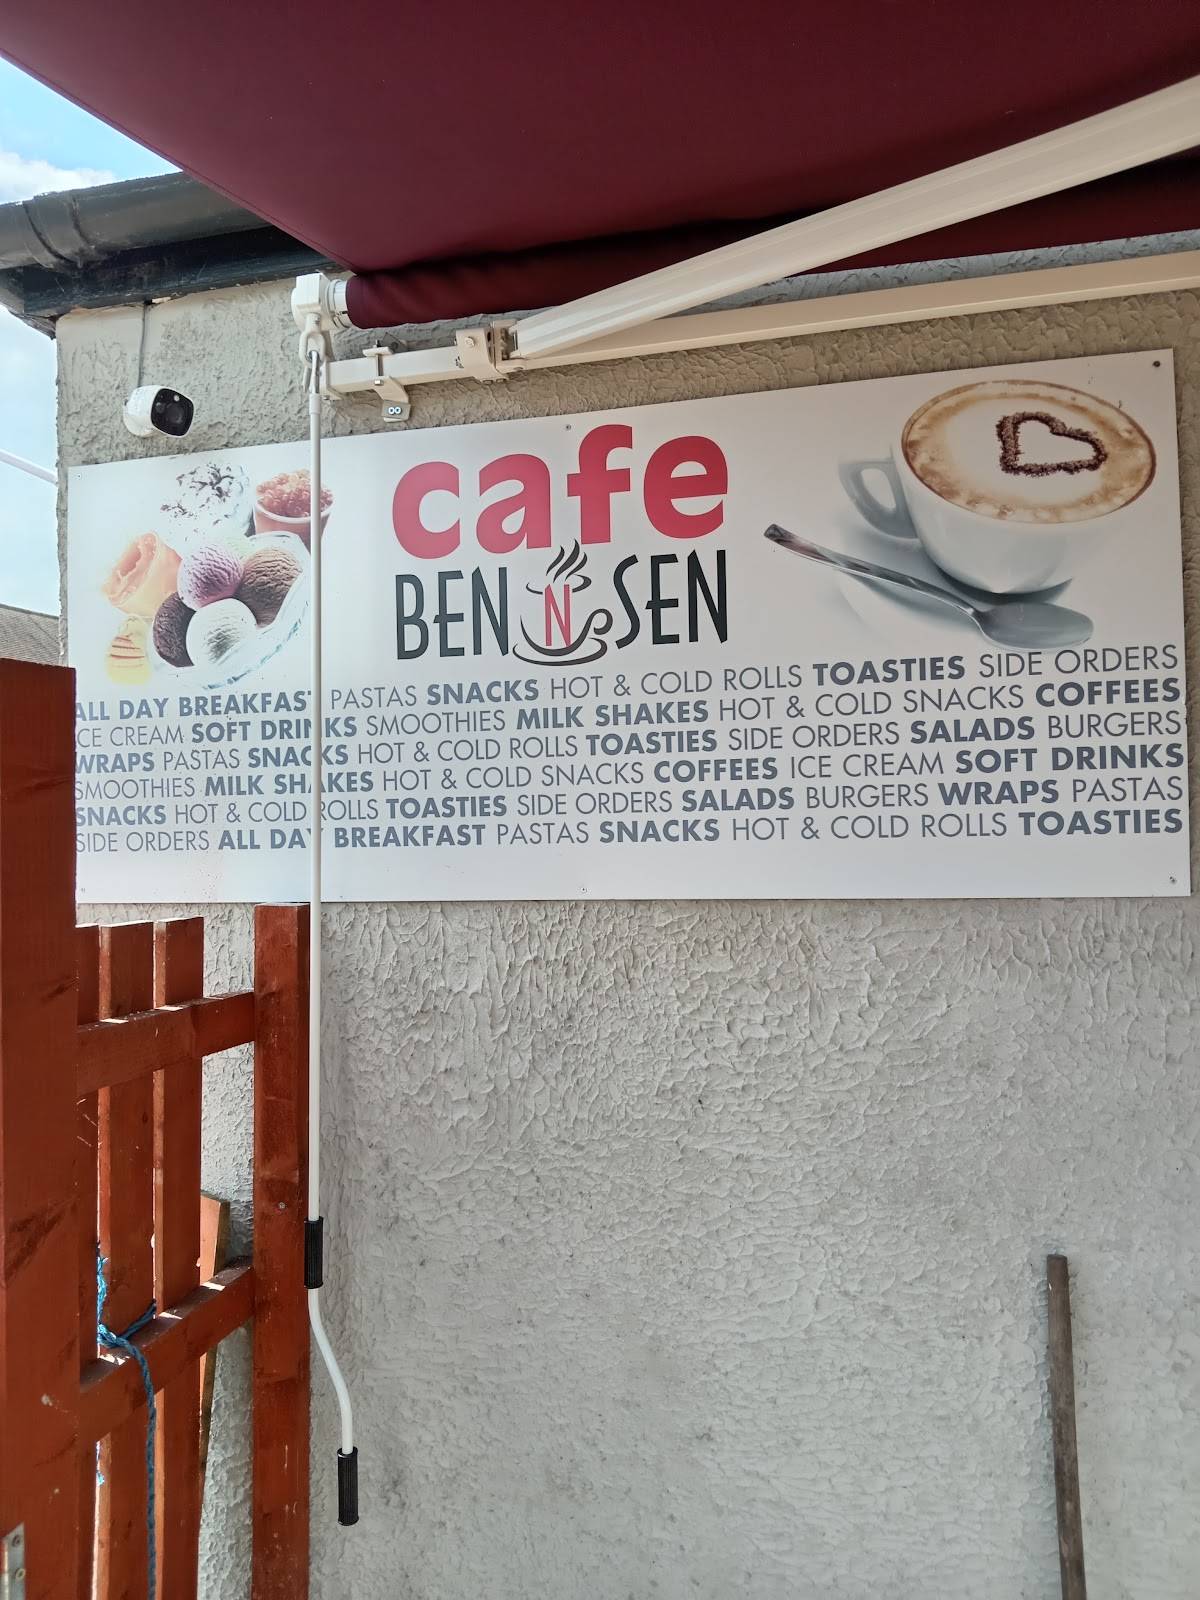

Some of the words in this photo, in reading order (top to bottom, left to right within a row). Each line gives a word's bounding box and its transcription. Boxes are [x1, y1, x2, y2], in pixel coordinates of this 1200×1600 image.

[392, 424, 728, 559] cafe
[395, 567, 508, 660] BEN
[545, 584, 570, 647] N
[613, 549, 727, 649] SEN
[77, 728, 101, 748] CE
[110, 726, 183, 746] CREAM
[191, 722, 250, 743] SOFT
[366, 709, 506, 735] SMOOTHIES
[517, 706, 584, 730] MILK
[595, 700, 709, 726] SHAKES
[720, 698, 774, 720] HOT
[786, 695, 806, 718] &
[816, 692, 891, 716] COLD
[903, 685, 1023, 713] SNACKS
[1036, 678, 1180, 707] COFFEES
[119, 698, 169, 719] DAY
[179, 691, 312, 717] BREAKFAS
[332, 685, 416, 709] PASTAS
[427, 679, 539, 705] SNACKS
[552, 676, 602, 699] HOT
[614, 675, 631, 696] &
[641, 671, 712, 694] COLD
[724, 664, 802, 691] ROLLS
[813, 656, 965, 686] TOASTIES
[979, 652, 1042, 678] SIDE
[1055, 645, 1178, 674] ORDERS
[76, 752, 154, 773] WRAPS
[164, 748, 240, 771] PASTAS
[248, 745, 348, 768] SNACKS
[359, 743, 405, 764] HOT
[414, 741, 430, 762] &
[438, 739, 500, 761] COLD
[510, 736, 578, 758] ROLLS
[586, 730, 717, 756] TOASTIES
[729, 727, 783, 750] SIDE
[793, 722, 899, 748] ORDERS
[911, 716, 1034, 744] SALADS
[1049, 711, 1181, 738] BURGERS
[76, 778, 195, 800] SMOOTHIES
[205, 775, 264, 797] MILK
[384, 769, 431, 791] HOT
[441, 769, 457, 789] &
[466, 767, 531, 788] COLD
[542, 762, 643, 786] SNACKS
[654, 758, 778, 783] COFFEES
[792, 756, 831, 778] ICE
[843, 752, 944, 777] CREAM
[956, 748, 1037, 774] SOFT
[1052, 743, 1184, 771] DRINKS
[76, 805, 166, 826] SNACKS
[176, 803, 218, 824] HOT
[227, 803, 241, 822] &
[249, 802, 306, 822] COLD
[386, 796, 507, 819] TOASTIES
[518, 794, 566, 815] SIDE
[576, 791, 672, 814] ORDERS
[682, 787, 794, 812] SALADS
[807, 783, 928, 808] BURGERS
[938, 780, 1059, 805] WRAPS
[1073, 776, 1183, 802] PASTAS
[76, 832, 117, 852] SIDE
[127, 831, 210, 851] ORDERS
[218, 830, 260, 850] ALL
[271, 828, 324, 849] DA
[334, 825, 485, 848] BREAKFAST
[498, 822, 589, 845] PASTAS
[600, 819, 719, 843] SNACKS
[733, 818, 788, 841] HOT
[801, 817, 819, 839] &
[831, 815, 908, 838] COLD
[922, 813, 1007, 837] ROLLS
[1019, 809, 1182, 836] TOASTIES
